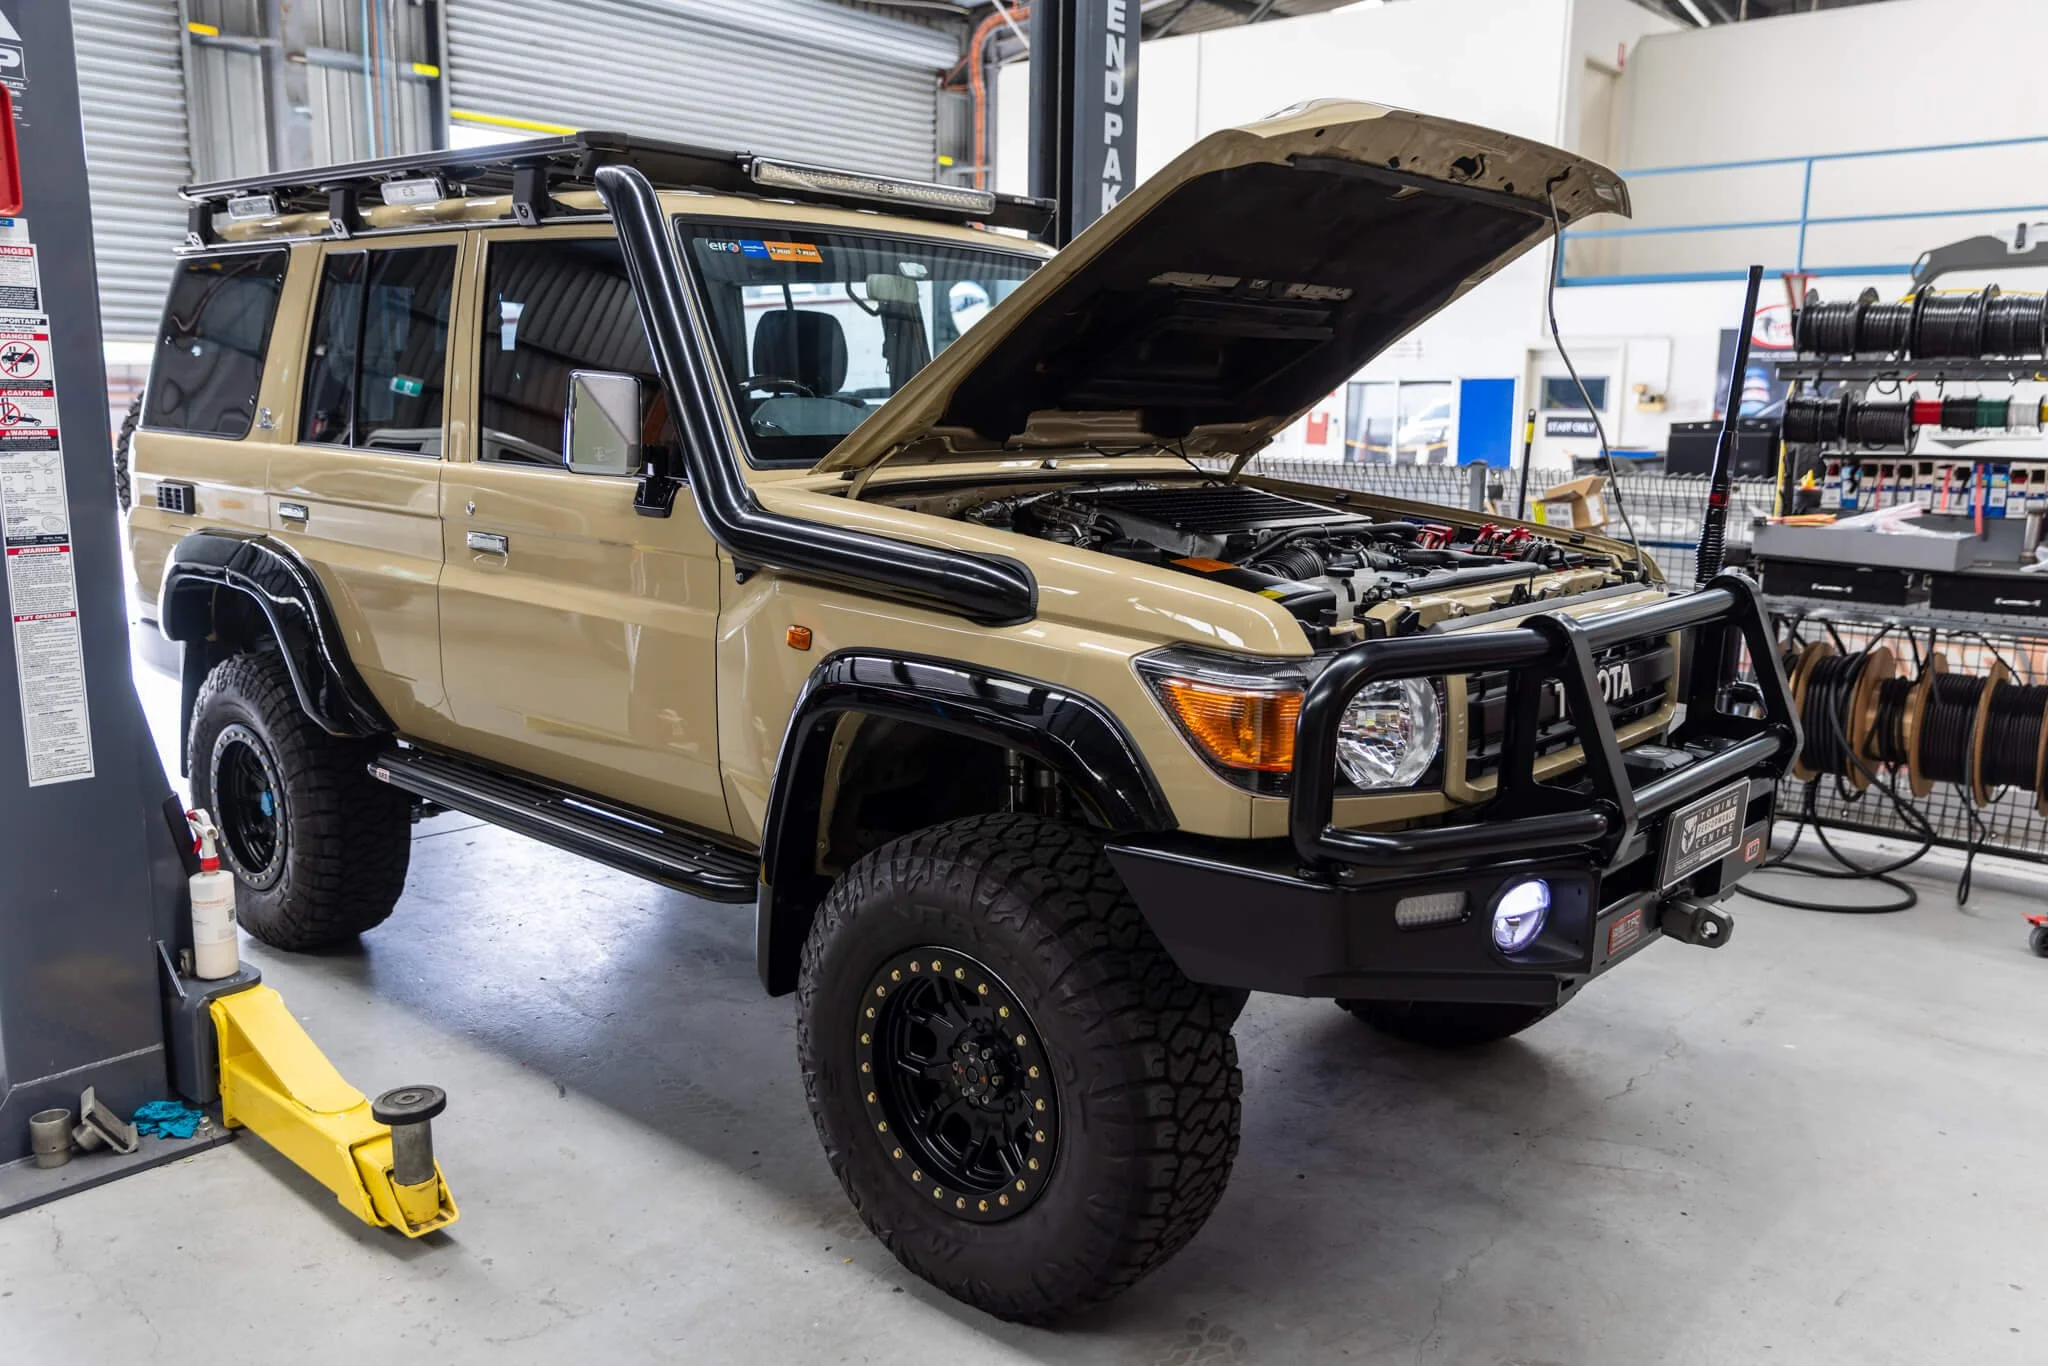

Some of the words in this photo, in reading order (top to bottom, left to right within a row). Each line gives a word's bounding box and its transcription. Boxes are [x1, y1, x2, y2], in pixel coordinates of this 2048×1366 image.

[1548, 421, 1572, 433] STAFF
[1572, 421, 1596, 433] ONLY
[24, 546, 60, 554] WARNING
[35, 611, 71, 619] OPERATION
[1700, 795, 1739, 820] TOWING
[1696, 823, 1734, 848] CENTRE
